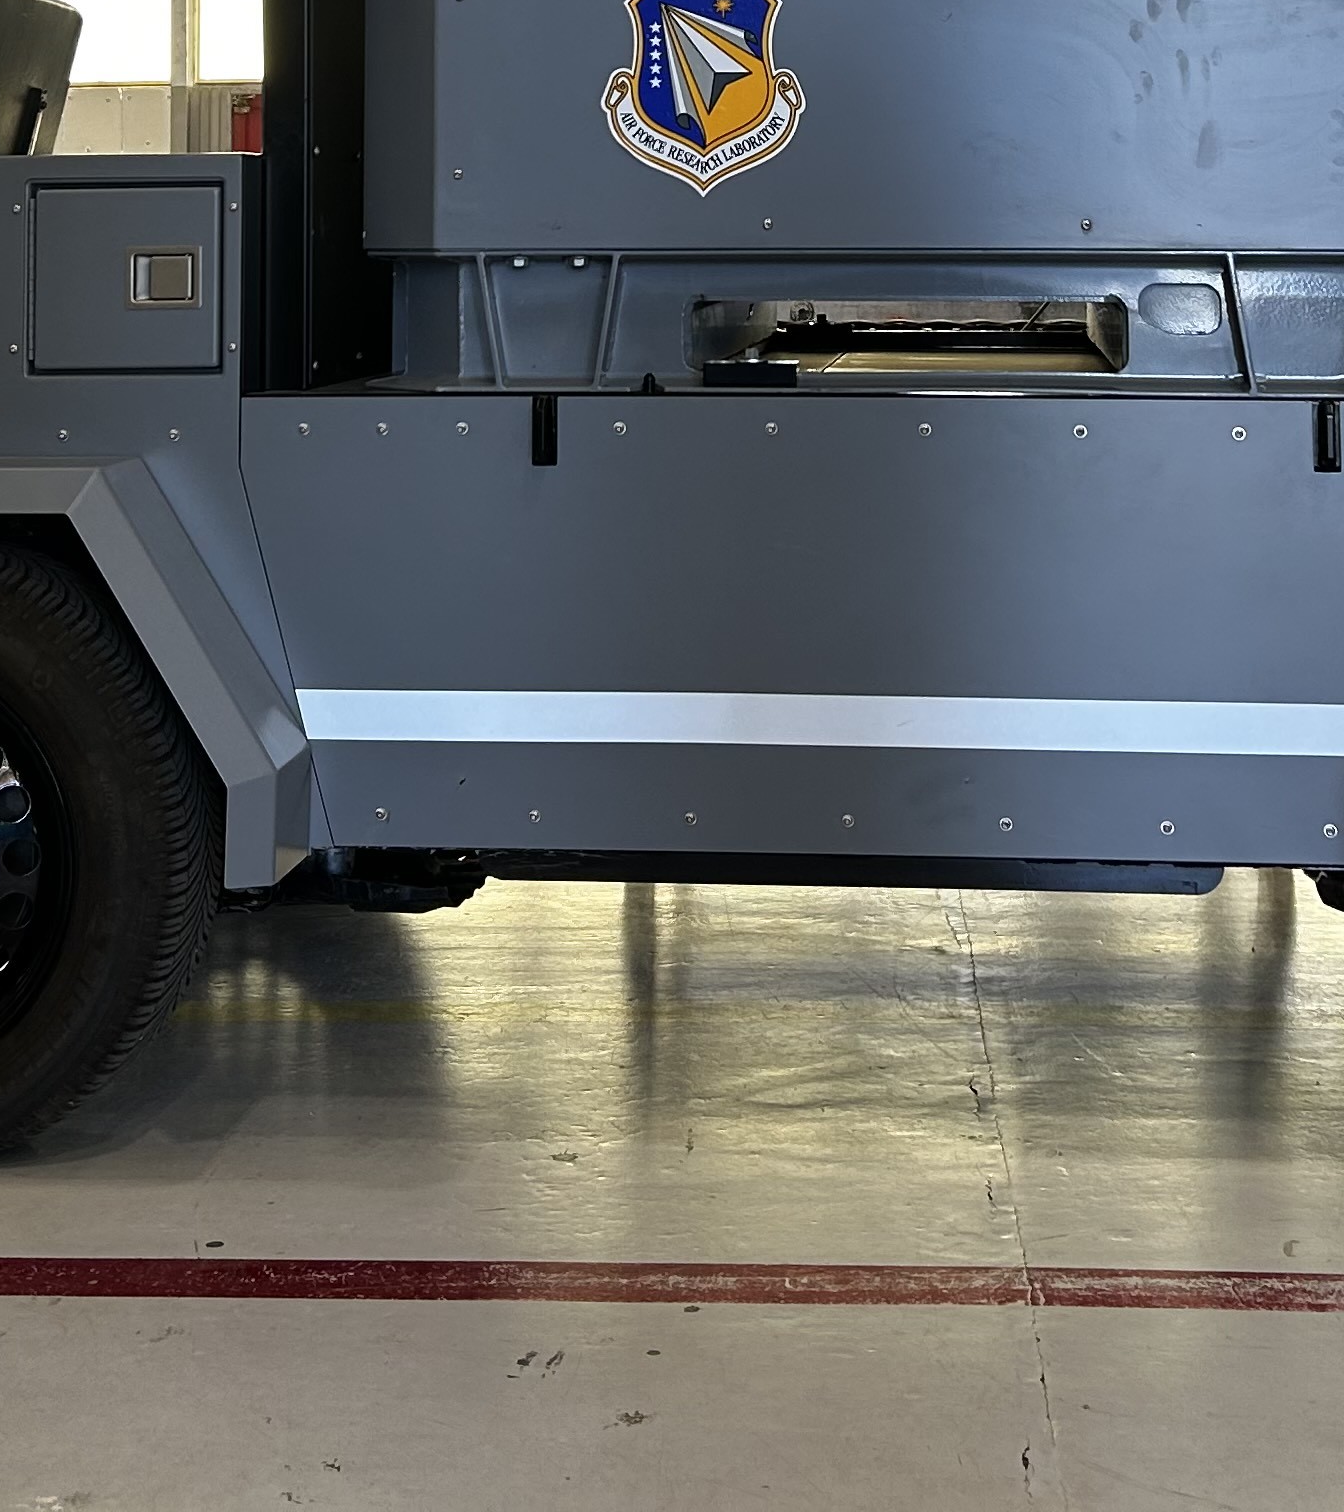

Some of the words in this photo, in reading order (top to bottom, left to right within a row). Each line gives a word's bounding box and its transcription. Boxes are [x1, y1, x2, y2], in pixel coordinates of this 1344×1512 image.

[620, 112, 638, 131] AIR
[632, 127, 668, 154] FORCE
[668, 144, 723, 174] RESEARCH
[722, 111, 786, 161] LABORATORY
